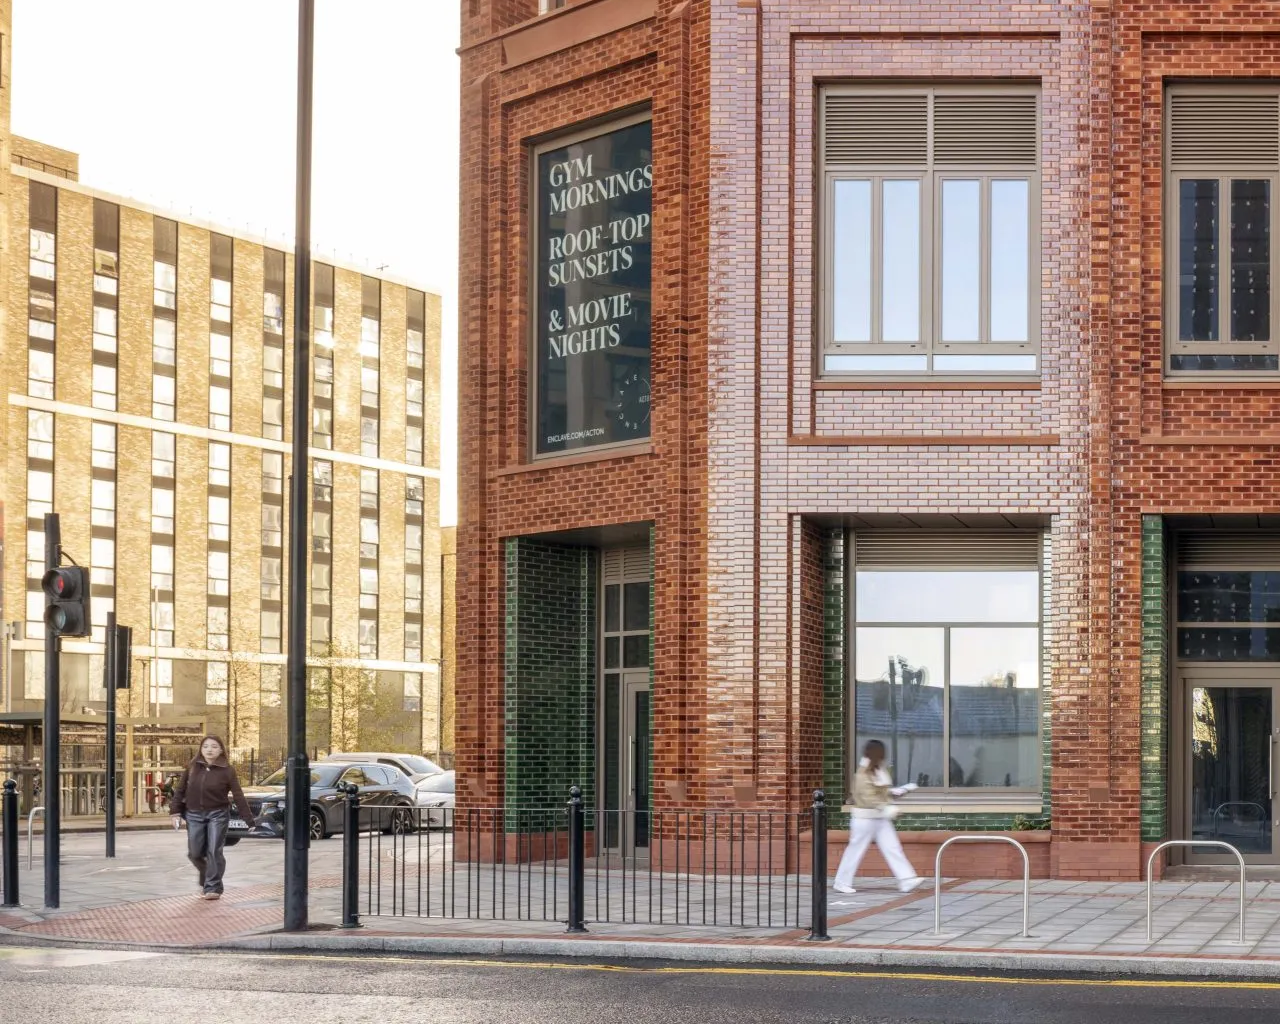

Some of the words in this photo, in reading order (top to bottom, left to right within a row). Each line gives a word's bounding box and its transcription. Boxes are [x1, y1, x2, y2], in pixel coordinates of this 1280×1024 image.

[549, 154, 593, 187] GYM
[549, 164, 652, 216] MORNINGS
[549, 213, 650, 260] ROOF-TOP
[549, 245, 633, 287] SUNSETS
[549, 309, 564, 332] &
[568, 292, 632, 329] MOVIE
[549, 323, 620, 360] NIGHTS
[547, 428, 605, 444] ENCLAVE.COM/ACTON
